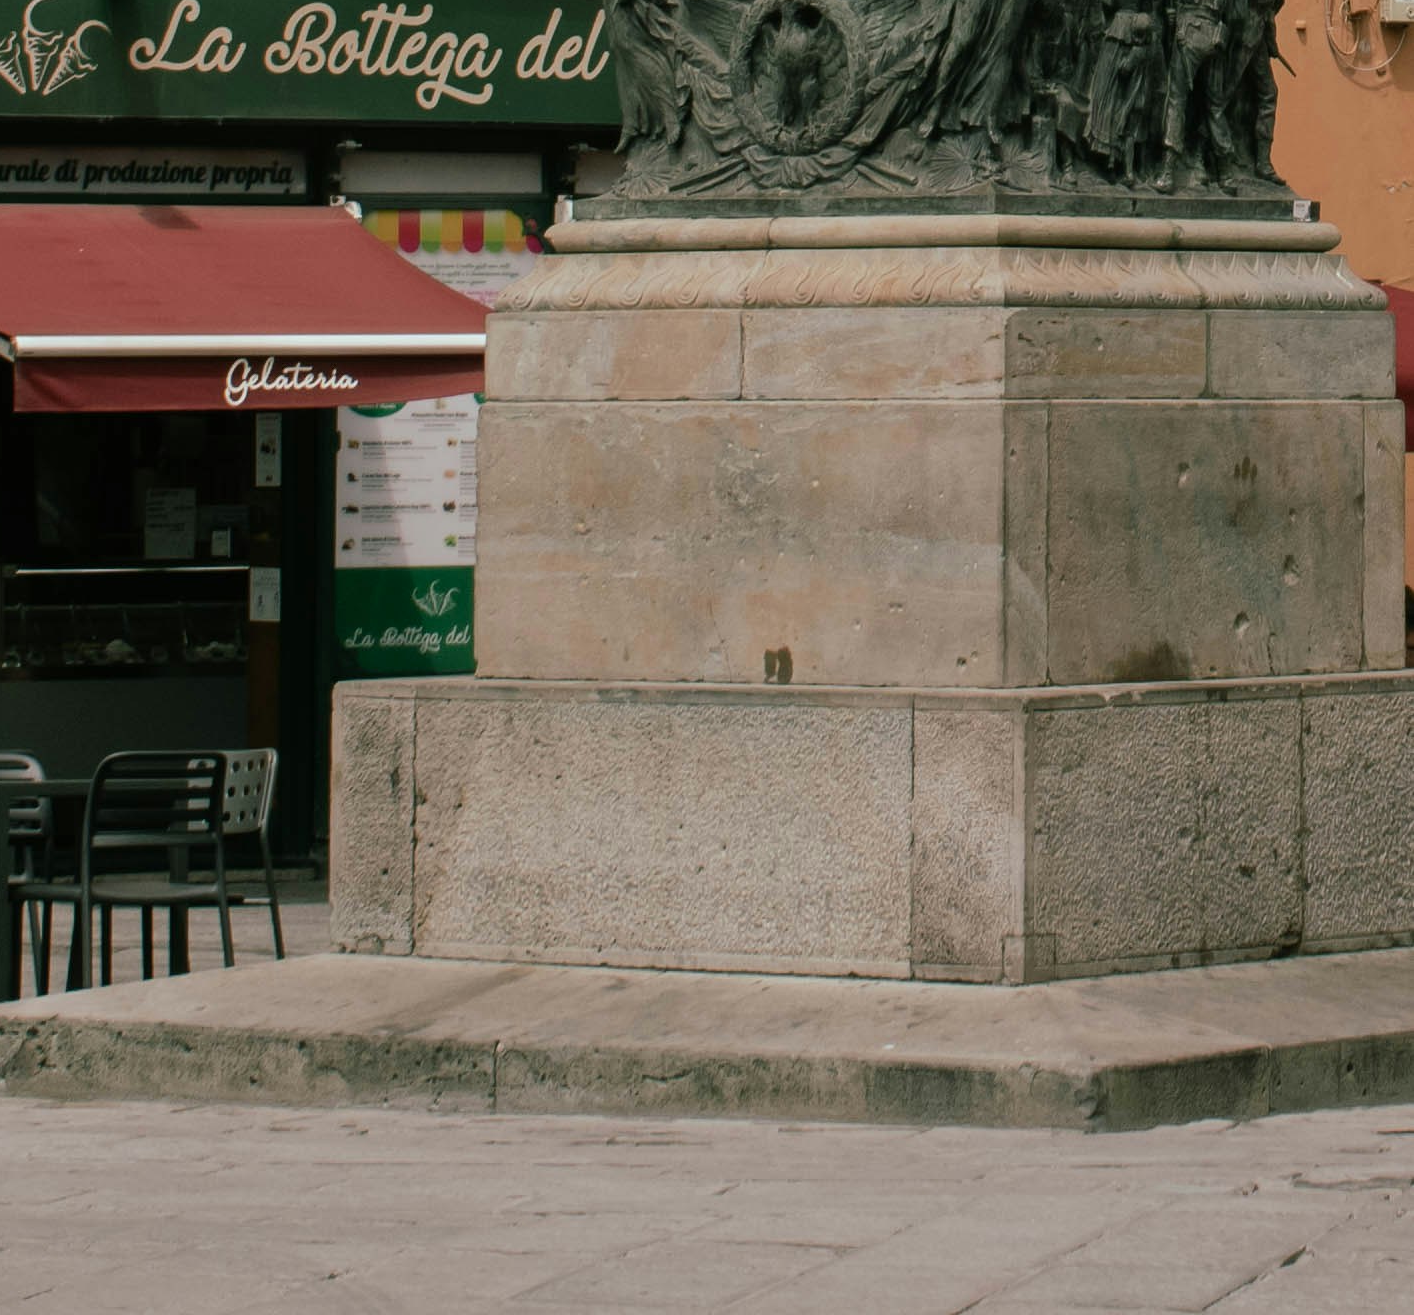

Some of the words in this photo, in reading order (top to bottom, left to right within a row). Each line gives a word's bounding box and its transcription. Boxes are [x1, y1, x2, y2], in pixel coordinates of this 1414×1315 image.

[264, 2, 503, 110] Bottega
[516, 7, 610, 80] del
[54, 158, 80, 182] di
[82, 159, 207, 190] produzione
[209, 161, 294, 191] propria
[224, 356, 359, 406] Gelateria
[344, 627, 375, 647] La
[379, 626, 443, 654] Bottega
[445, 624, 471, 644] del
